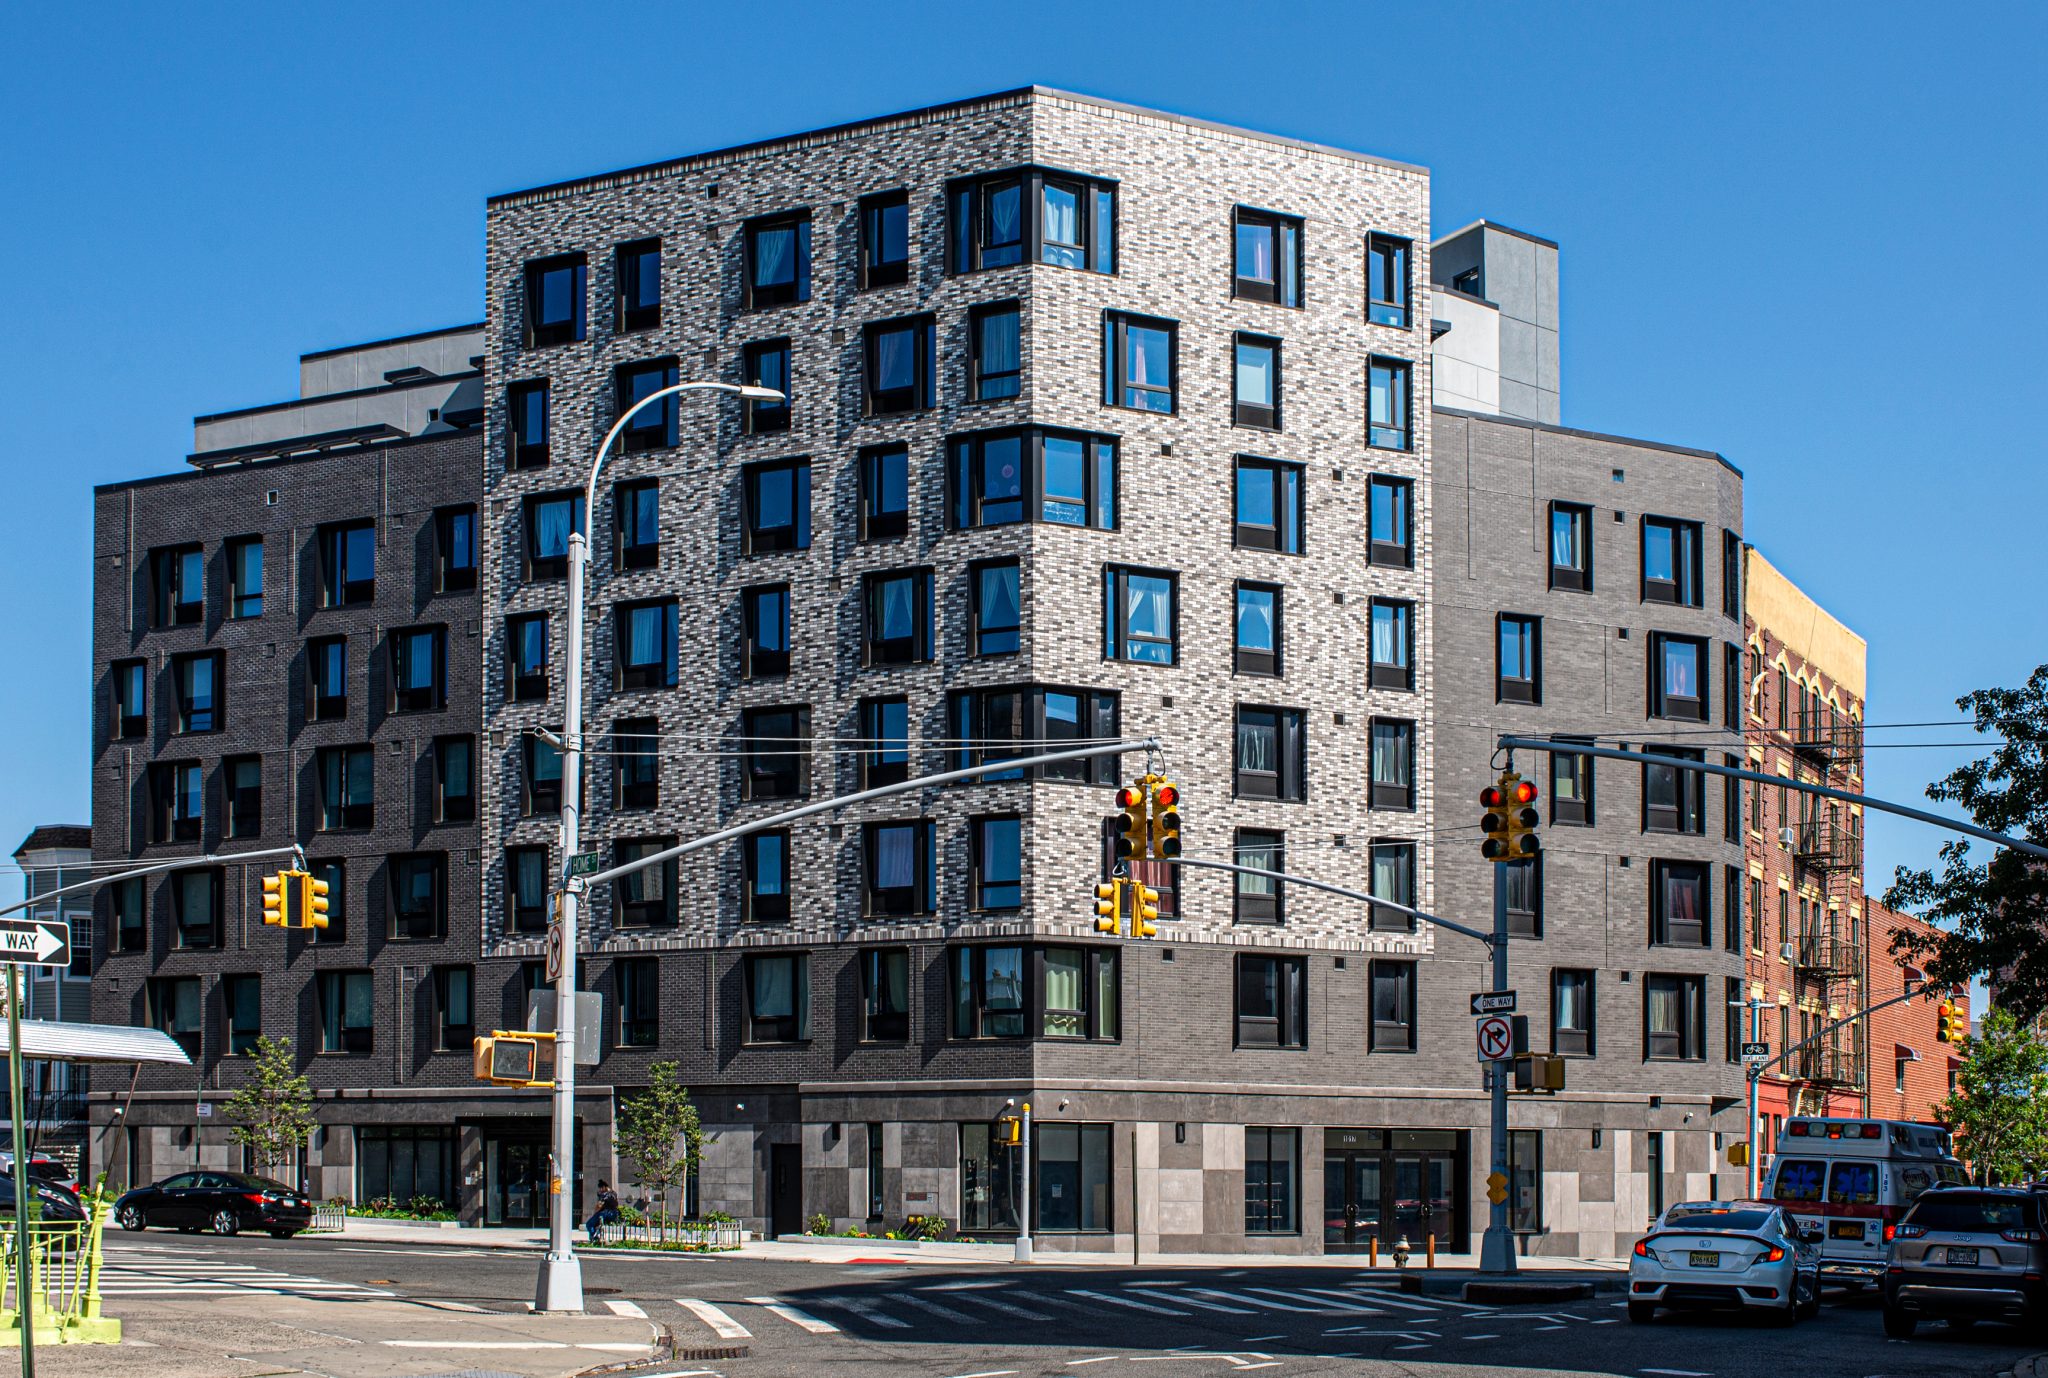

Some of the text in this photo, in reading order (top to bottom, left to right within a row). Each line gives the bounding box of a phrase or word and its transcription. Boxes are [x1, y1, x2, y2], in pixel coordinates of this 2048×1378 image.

[572, 854, 597, 873] HOME ST
[6, 933, 38, 950] WAY
[1482, 996, 1512, 1008] ONE WAY
[1954, 1234, 1971, 1242] Jeep
